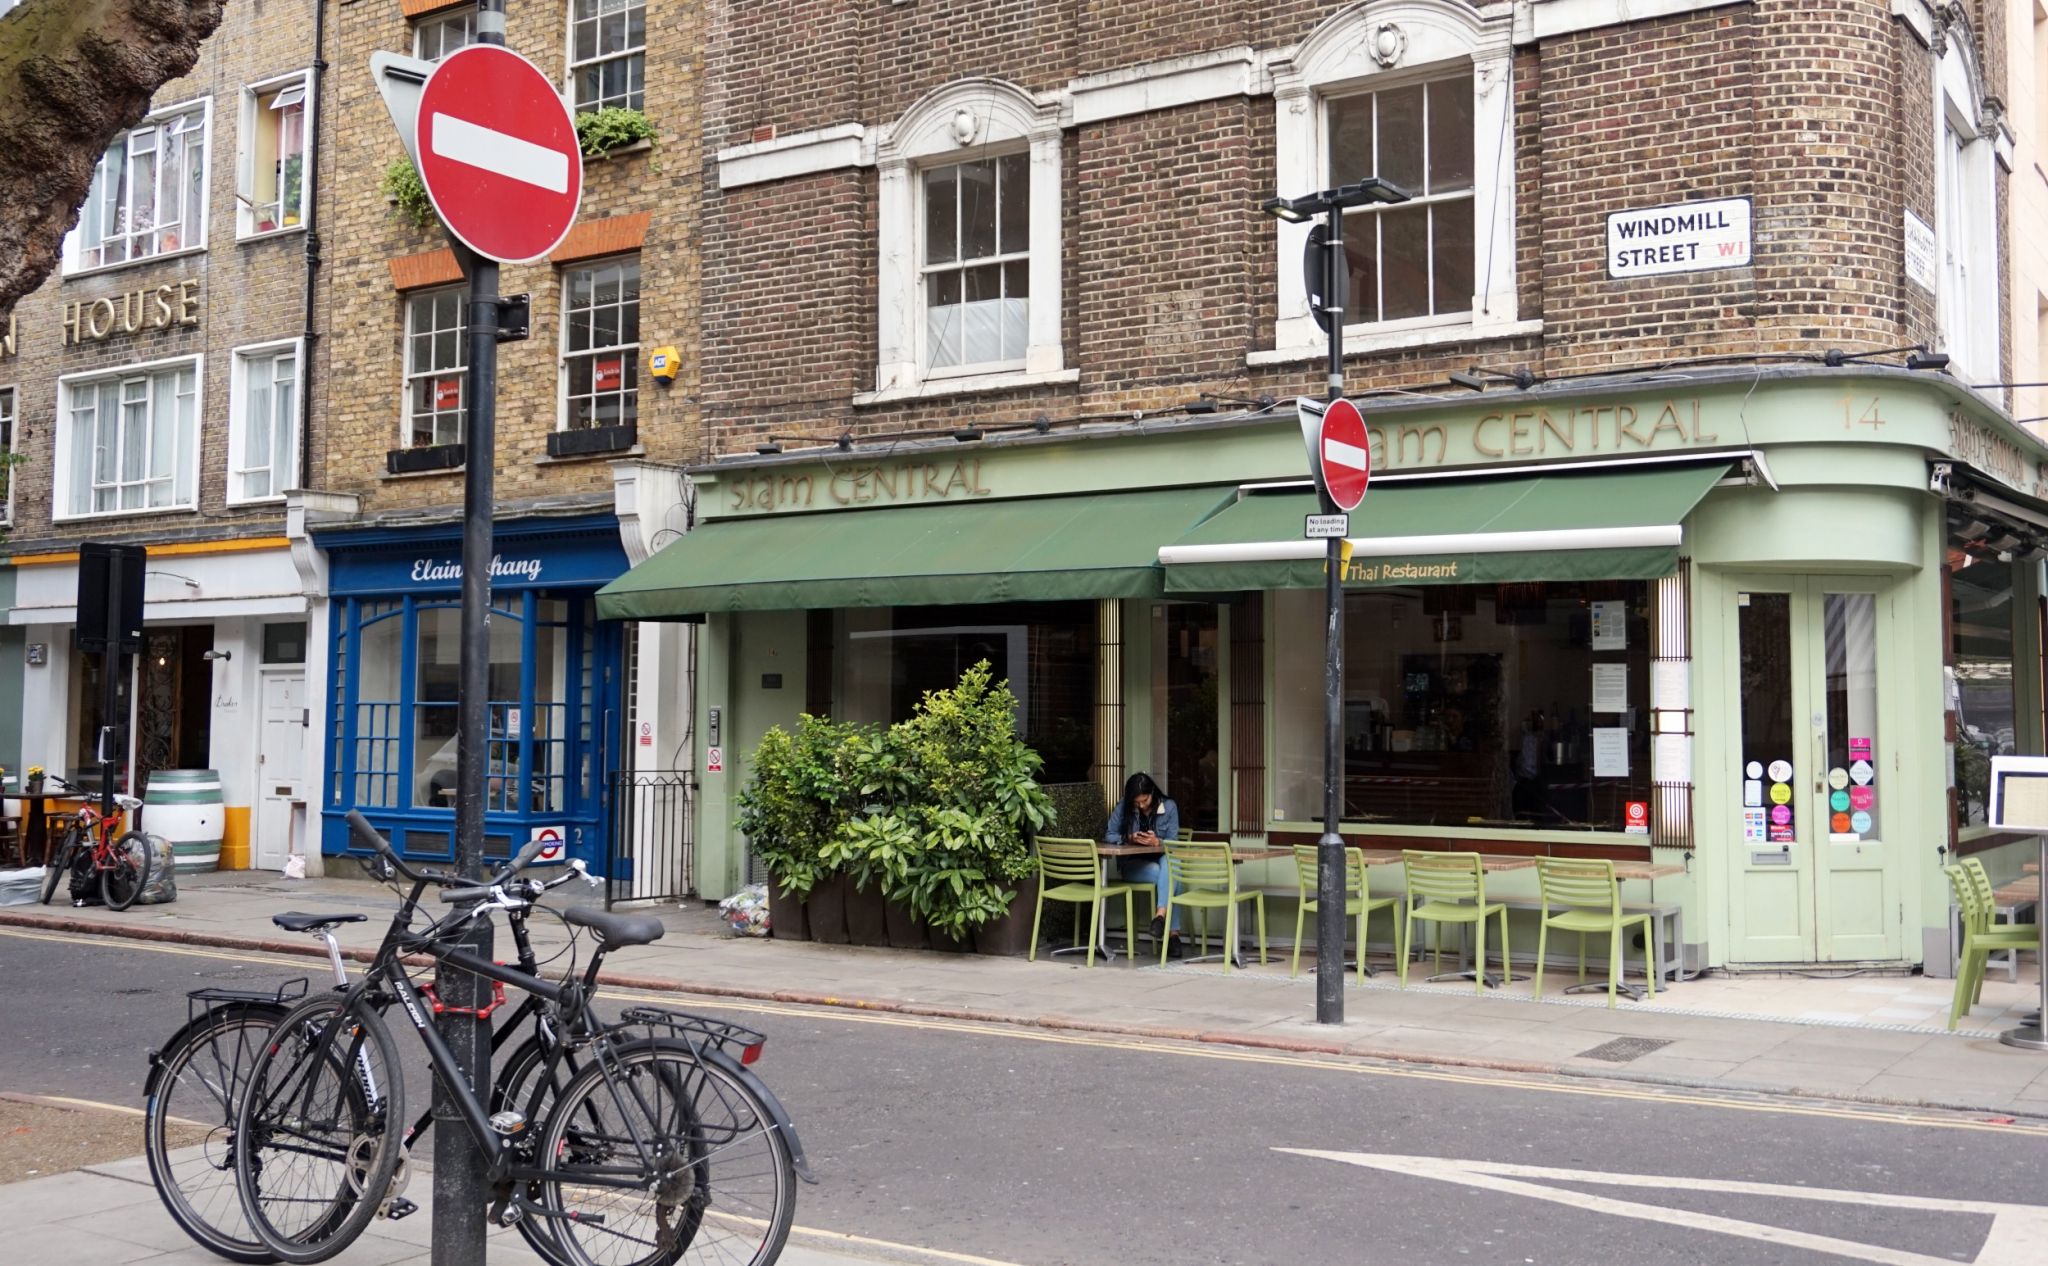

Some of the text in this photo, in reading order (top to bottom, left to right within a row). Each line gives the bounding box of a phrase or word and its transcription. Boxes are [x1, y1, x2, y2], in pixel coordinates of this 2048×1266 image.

[1616, 210, 1730, 240] WINDMILL
[1616, 242, 1700, 268] STREET
[62, 278, 199, 346] HOUSE
[1837, 390, 1886, 431] 14
[1369, 399, 1718, 470] am CENTRAL
[828, 458, 992, 505] CENTRAL
[411, 554, 543, 581] Elain hang
[1349, 561, 1458, 581] Thai Restaurant
[574, 827, 583, 845] 2
[394, 981, 426, 1029] RALEIGH
